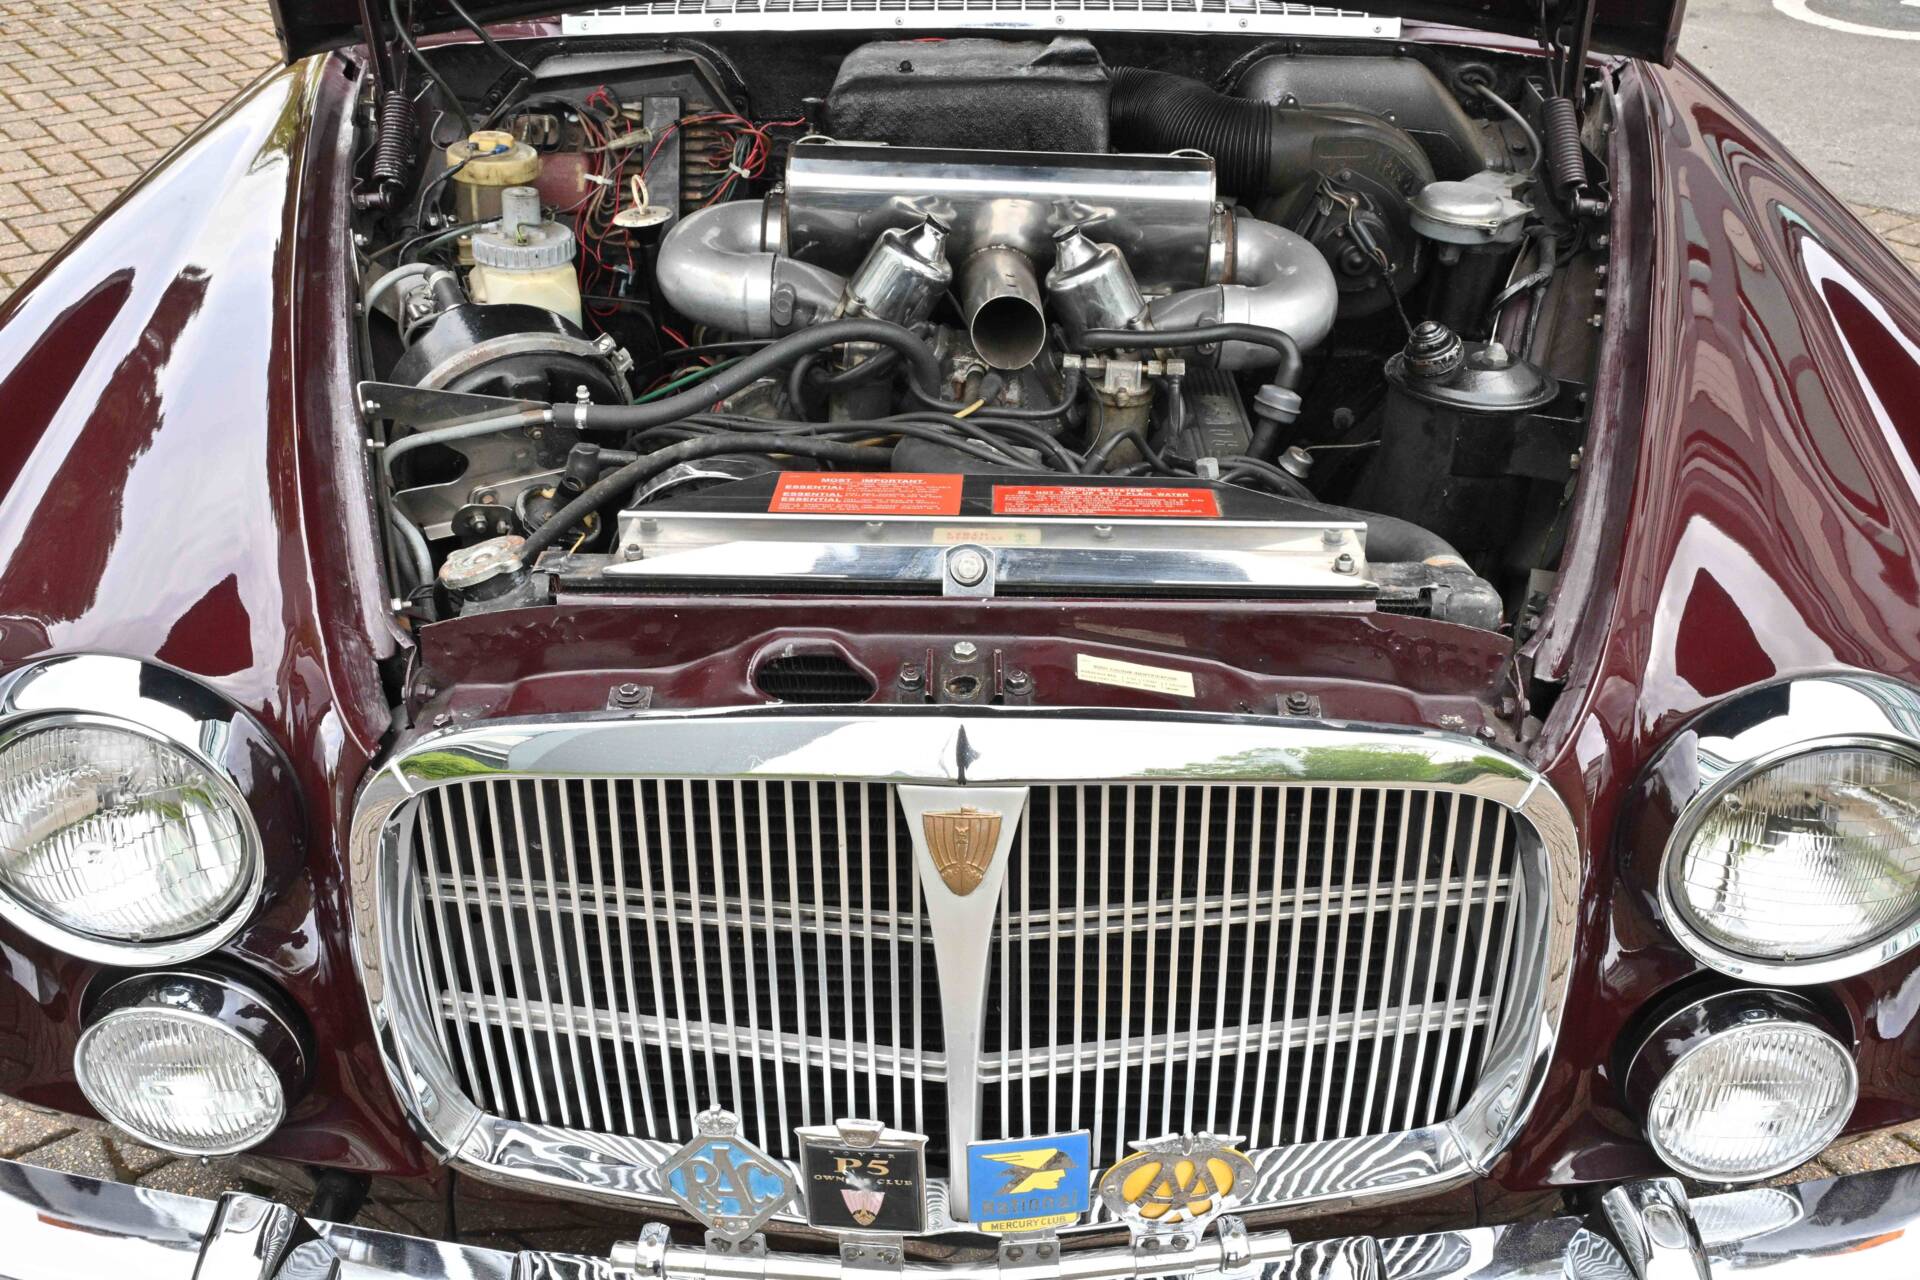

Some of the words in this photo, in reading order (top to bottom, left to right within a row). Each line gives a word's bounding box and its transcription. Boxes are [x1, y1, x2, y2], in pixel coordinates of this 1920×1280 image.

[832, 1156, 890, 1176] P5
[680, 1144, 783, 1216] RAC
[876, 1178, 913, 1186] CLUB
[990, 1218, 1040, 1231] MERCURY
[1040, 1215, 1067, 1226] CLUB
